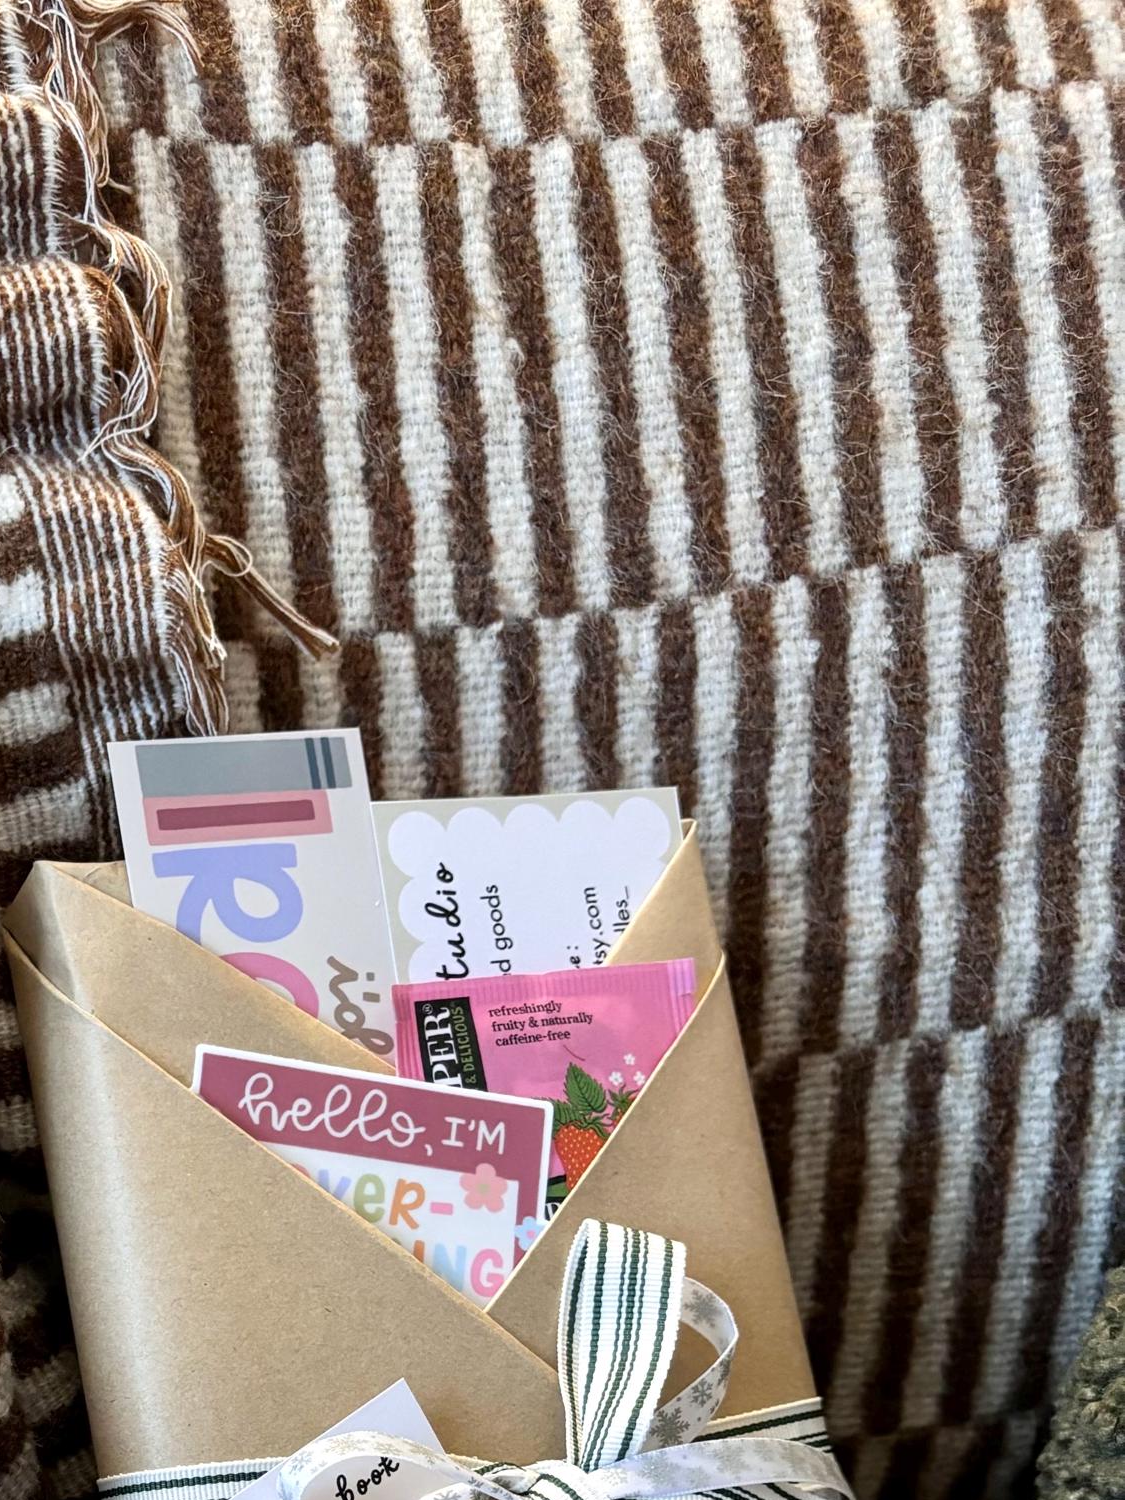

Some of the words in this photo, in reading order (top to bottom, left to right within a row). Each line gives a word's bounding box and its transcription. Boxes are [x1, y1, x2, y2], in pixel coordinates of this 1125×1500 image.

[480, 884, 514, 951] goods
[488, 1000, 563, 1018] refreshingly
[491, 1019, 526, 1033] fruity
[528, 1017, 540, 1029] &
[540, 1012, 594, 1027] naturally
[451, 1005, 476, 1073] DELICIOUS
[495, 1029, 571, 1047] caffeine-free
[465, 1073, 477, 1085] &
[237, 1072, 433, 1157] hello,
[441, 1115, 506, 1155] I'M
